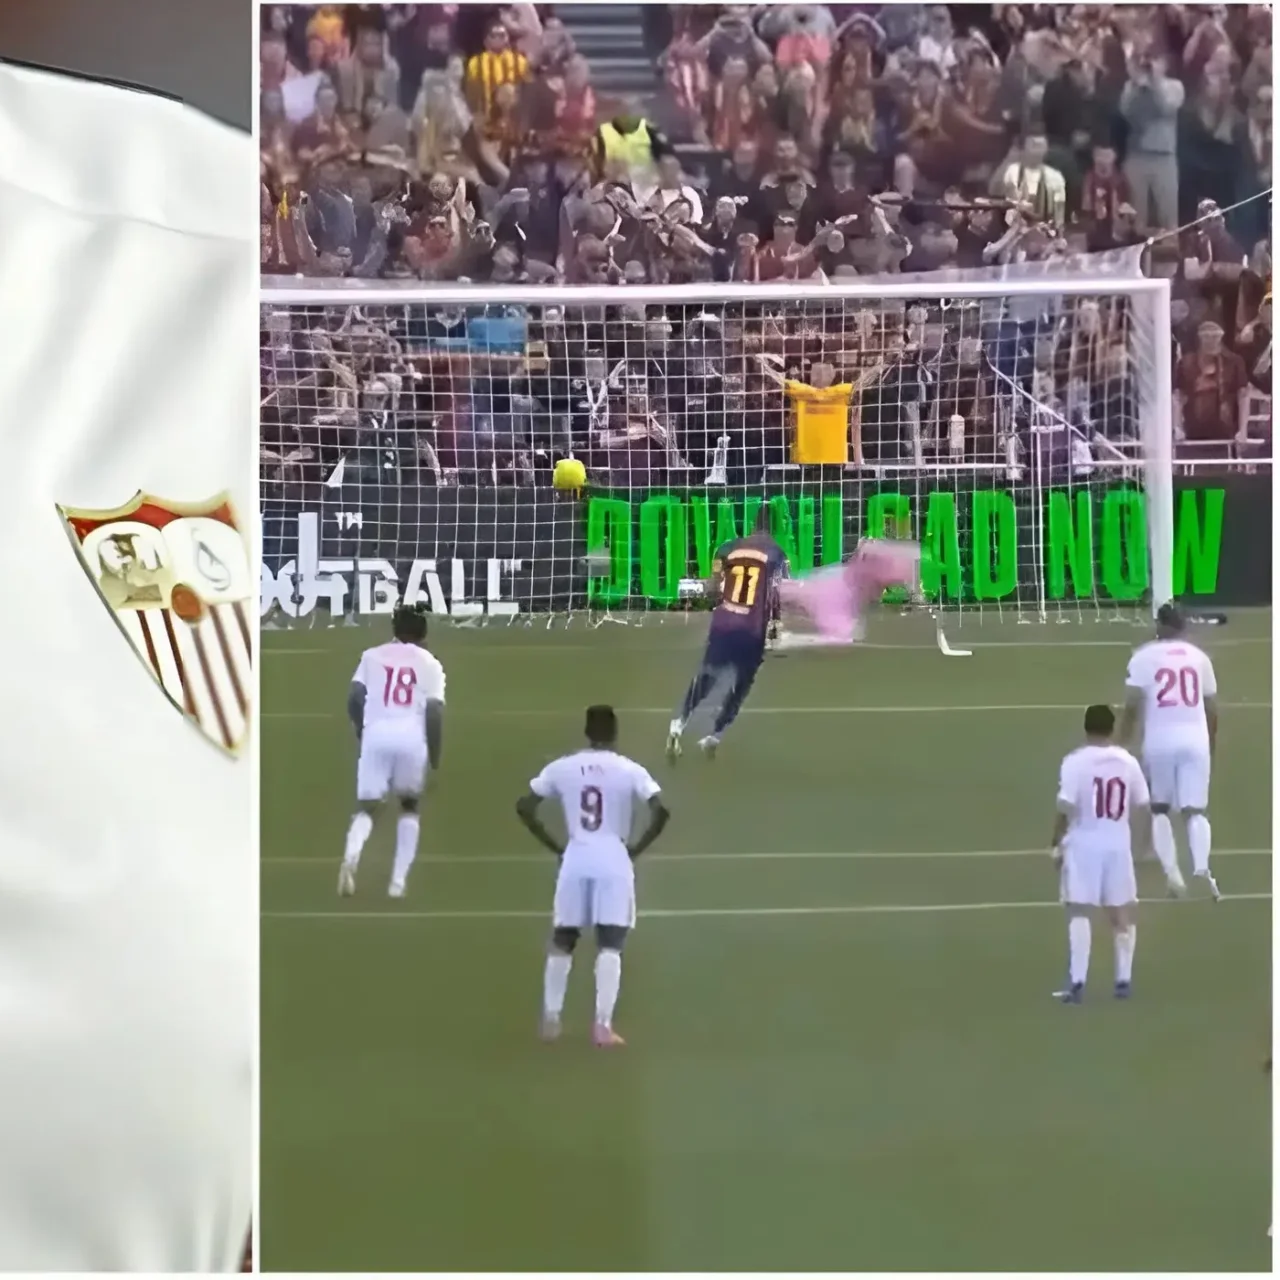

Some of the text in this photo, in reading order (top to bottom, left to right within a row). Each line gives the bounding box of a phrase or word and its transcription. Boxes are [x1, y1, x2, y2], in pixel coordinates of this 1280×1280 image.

[1049, 489, 1225, 599] NOW
[731, 566, 760, 605] 11
[382, 665, 417, 707] 18
[1154, 666, 1200, 708] 20
[581, 784, 602, 832] 9
[1093, 776, 1126, 821] 10
